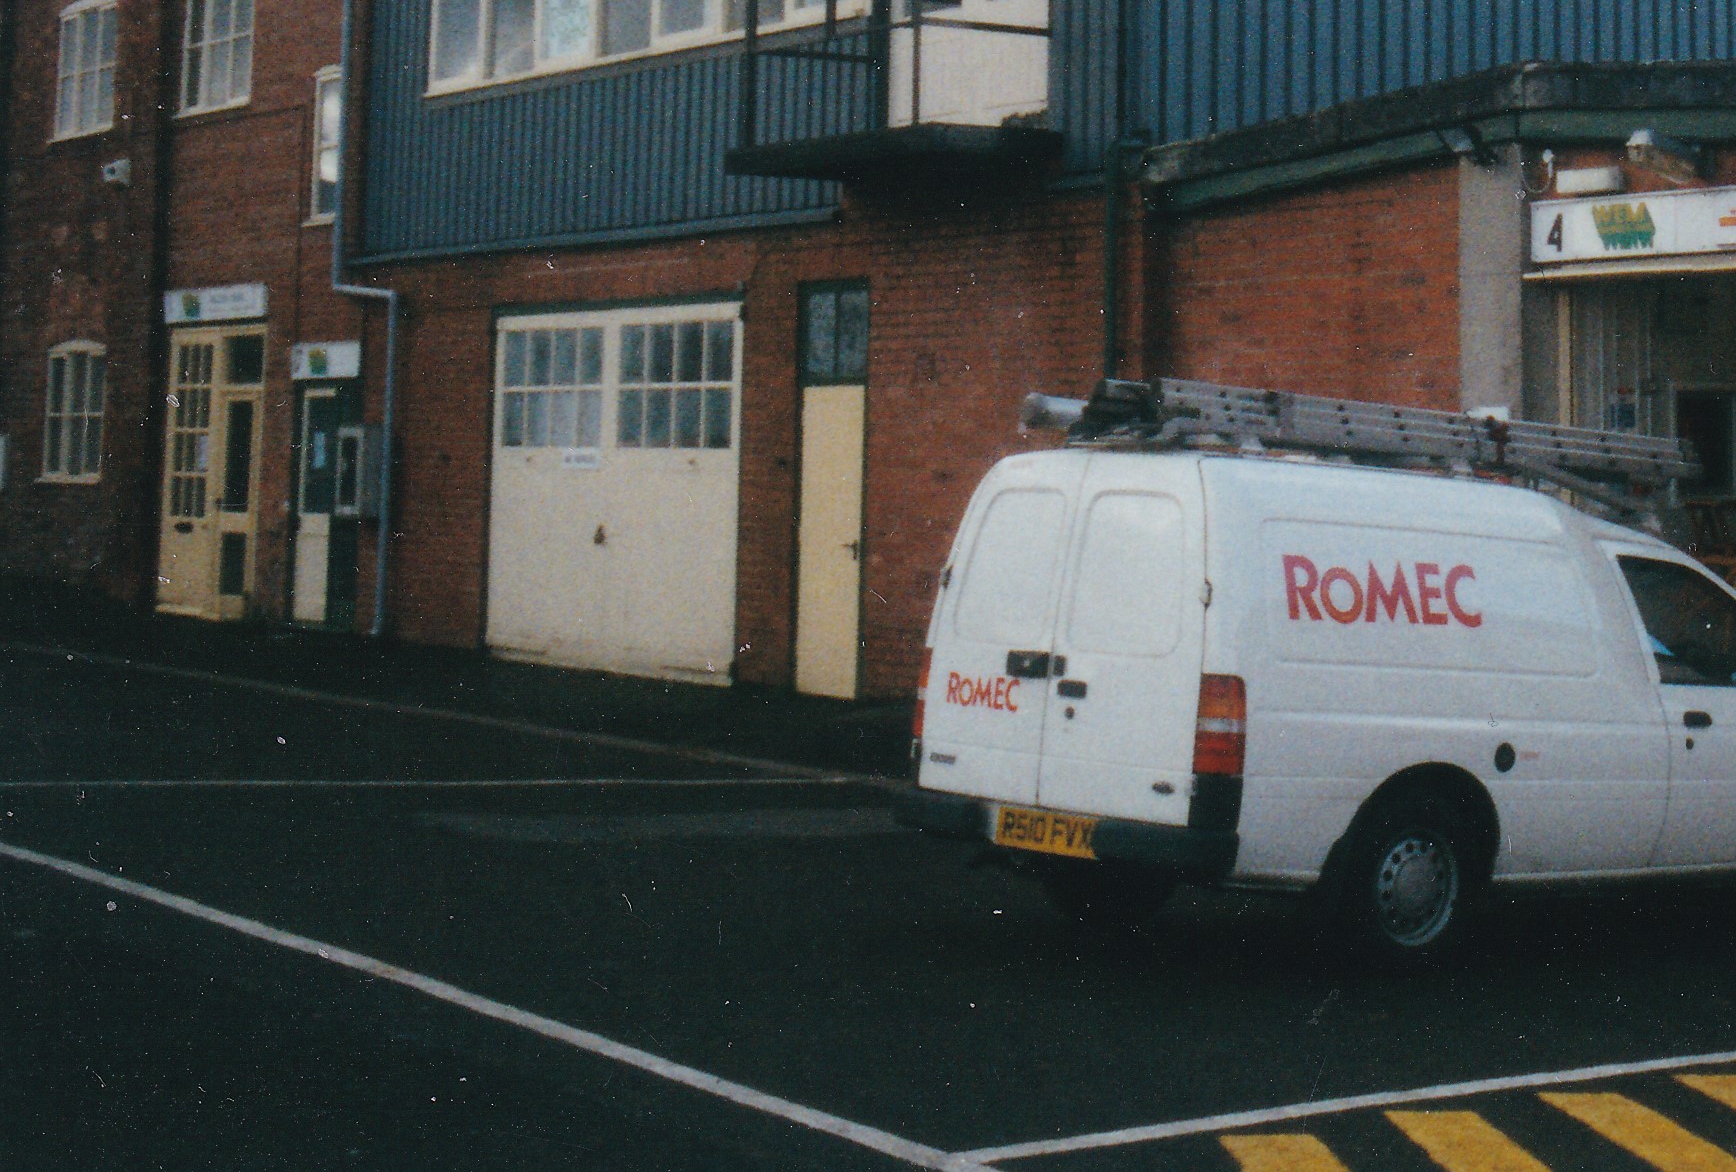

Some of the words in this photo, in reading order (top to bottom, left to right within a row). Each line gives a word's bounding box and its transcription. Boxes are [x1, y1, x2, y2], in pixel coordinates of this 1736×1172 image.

[1547, 212, 1563, 252] 4
[1592, 202, 1647, 223] WEM
[1281, 555, 1482, 628] ROMEC
[946, 670, 1020, 713] ROMEC
